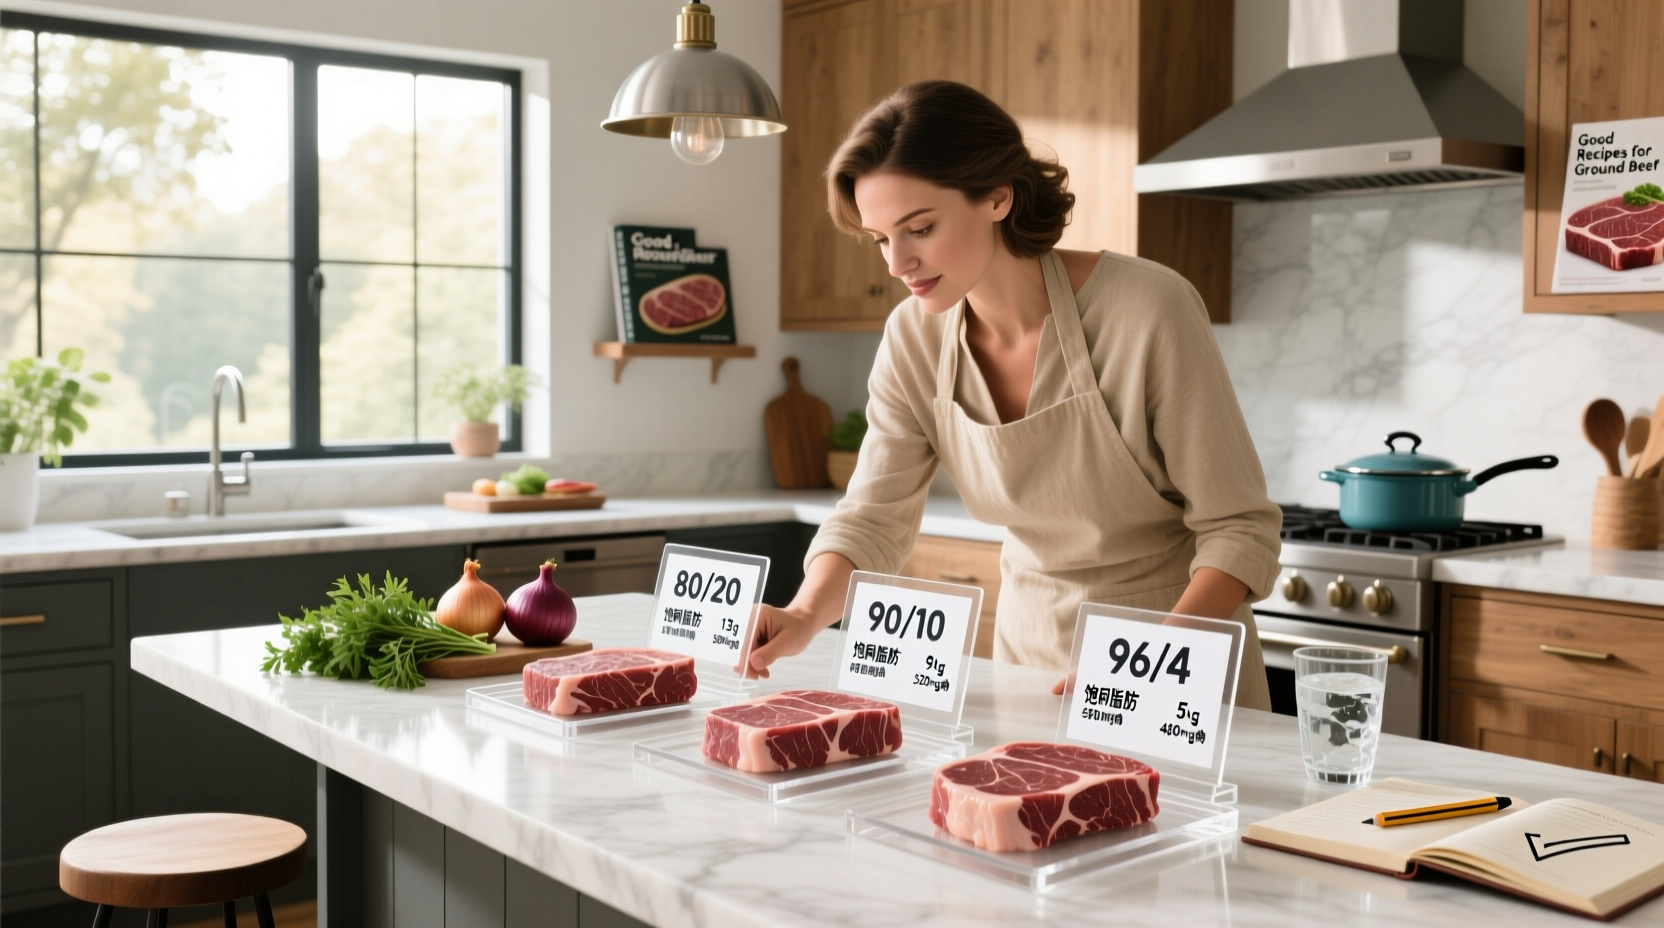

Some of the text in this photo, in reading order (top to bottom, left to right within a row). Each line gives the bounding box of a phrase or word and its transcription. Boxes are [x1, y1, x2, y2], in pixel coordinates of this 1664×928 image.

[1578, 131, 1614, 146] Good
[1576, 145, 1652, 162] Recipes for
[1574, 159, 1660, 176] Ground Beef
[673, 570, 742, 606] 80/20
[868, 601, 946, 642] 90/10
[1108, 637, 1191, 685] 96/4
